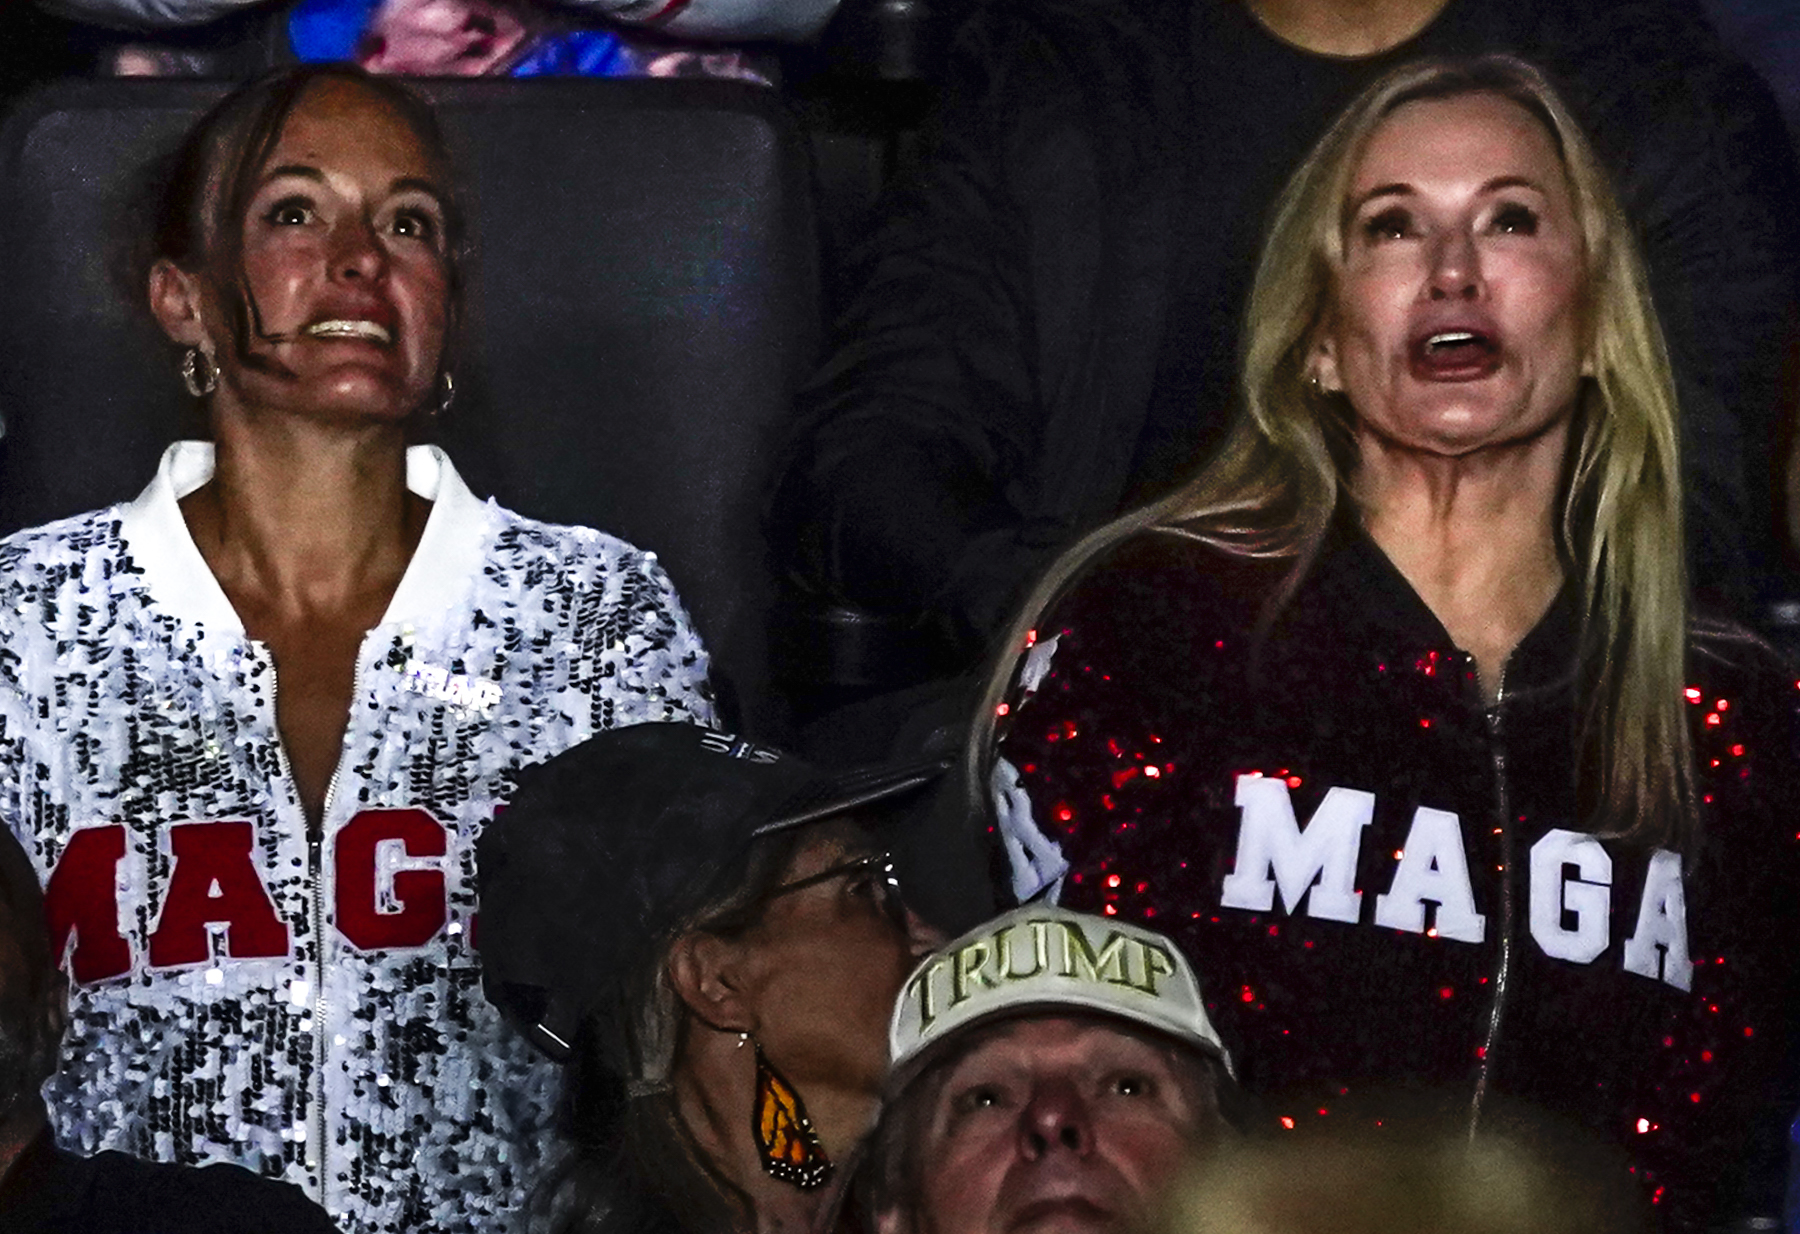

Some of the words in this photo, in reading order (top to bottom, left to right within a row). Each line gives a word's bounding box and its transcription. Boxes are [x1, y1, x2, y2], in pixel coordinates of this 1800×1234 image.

[45, 804, 502, 985] MAG
[1220, 774, 1694, 994] MAGA
[908, 918, 1176, 1037] TRUMP
